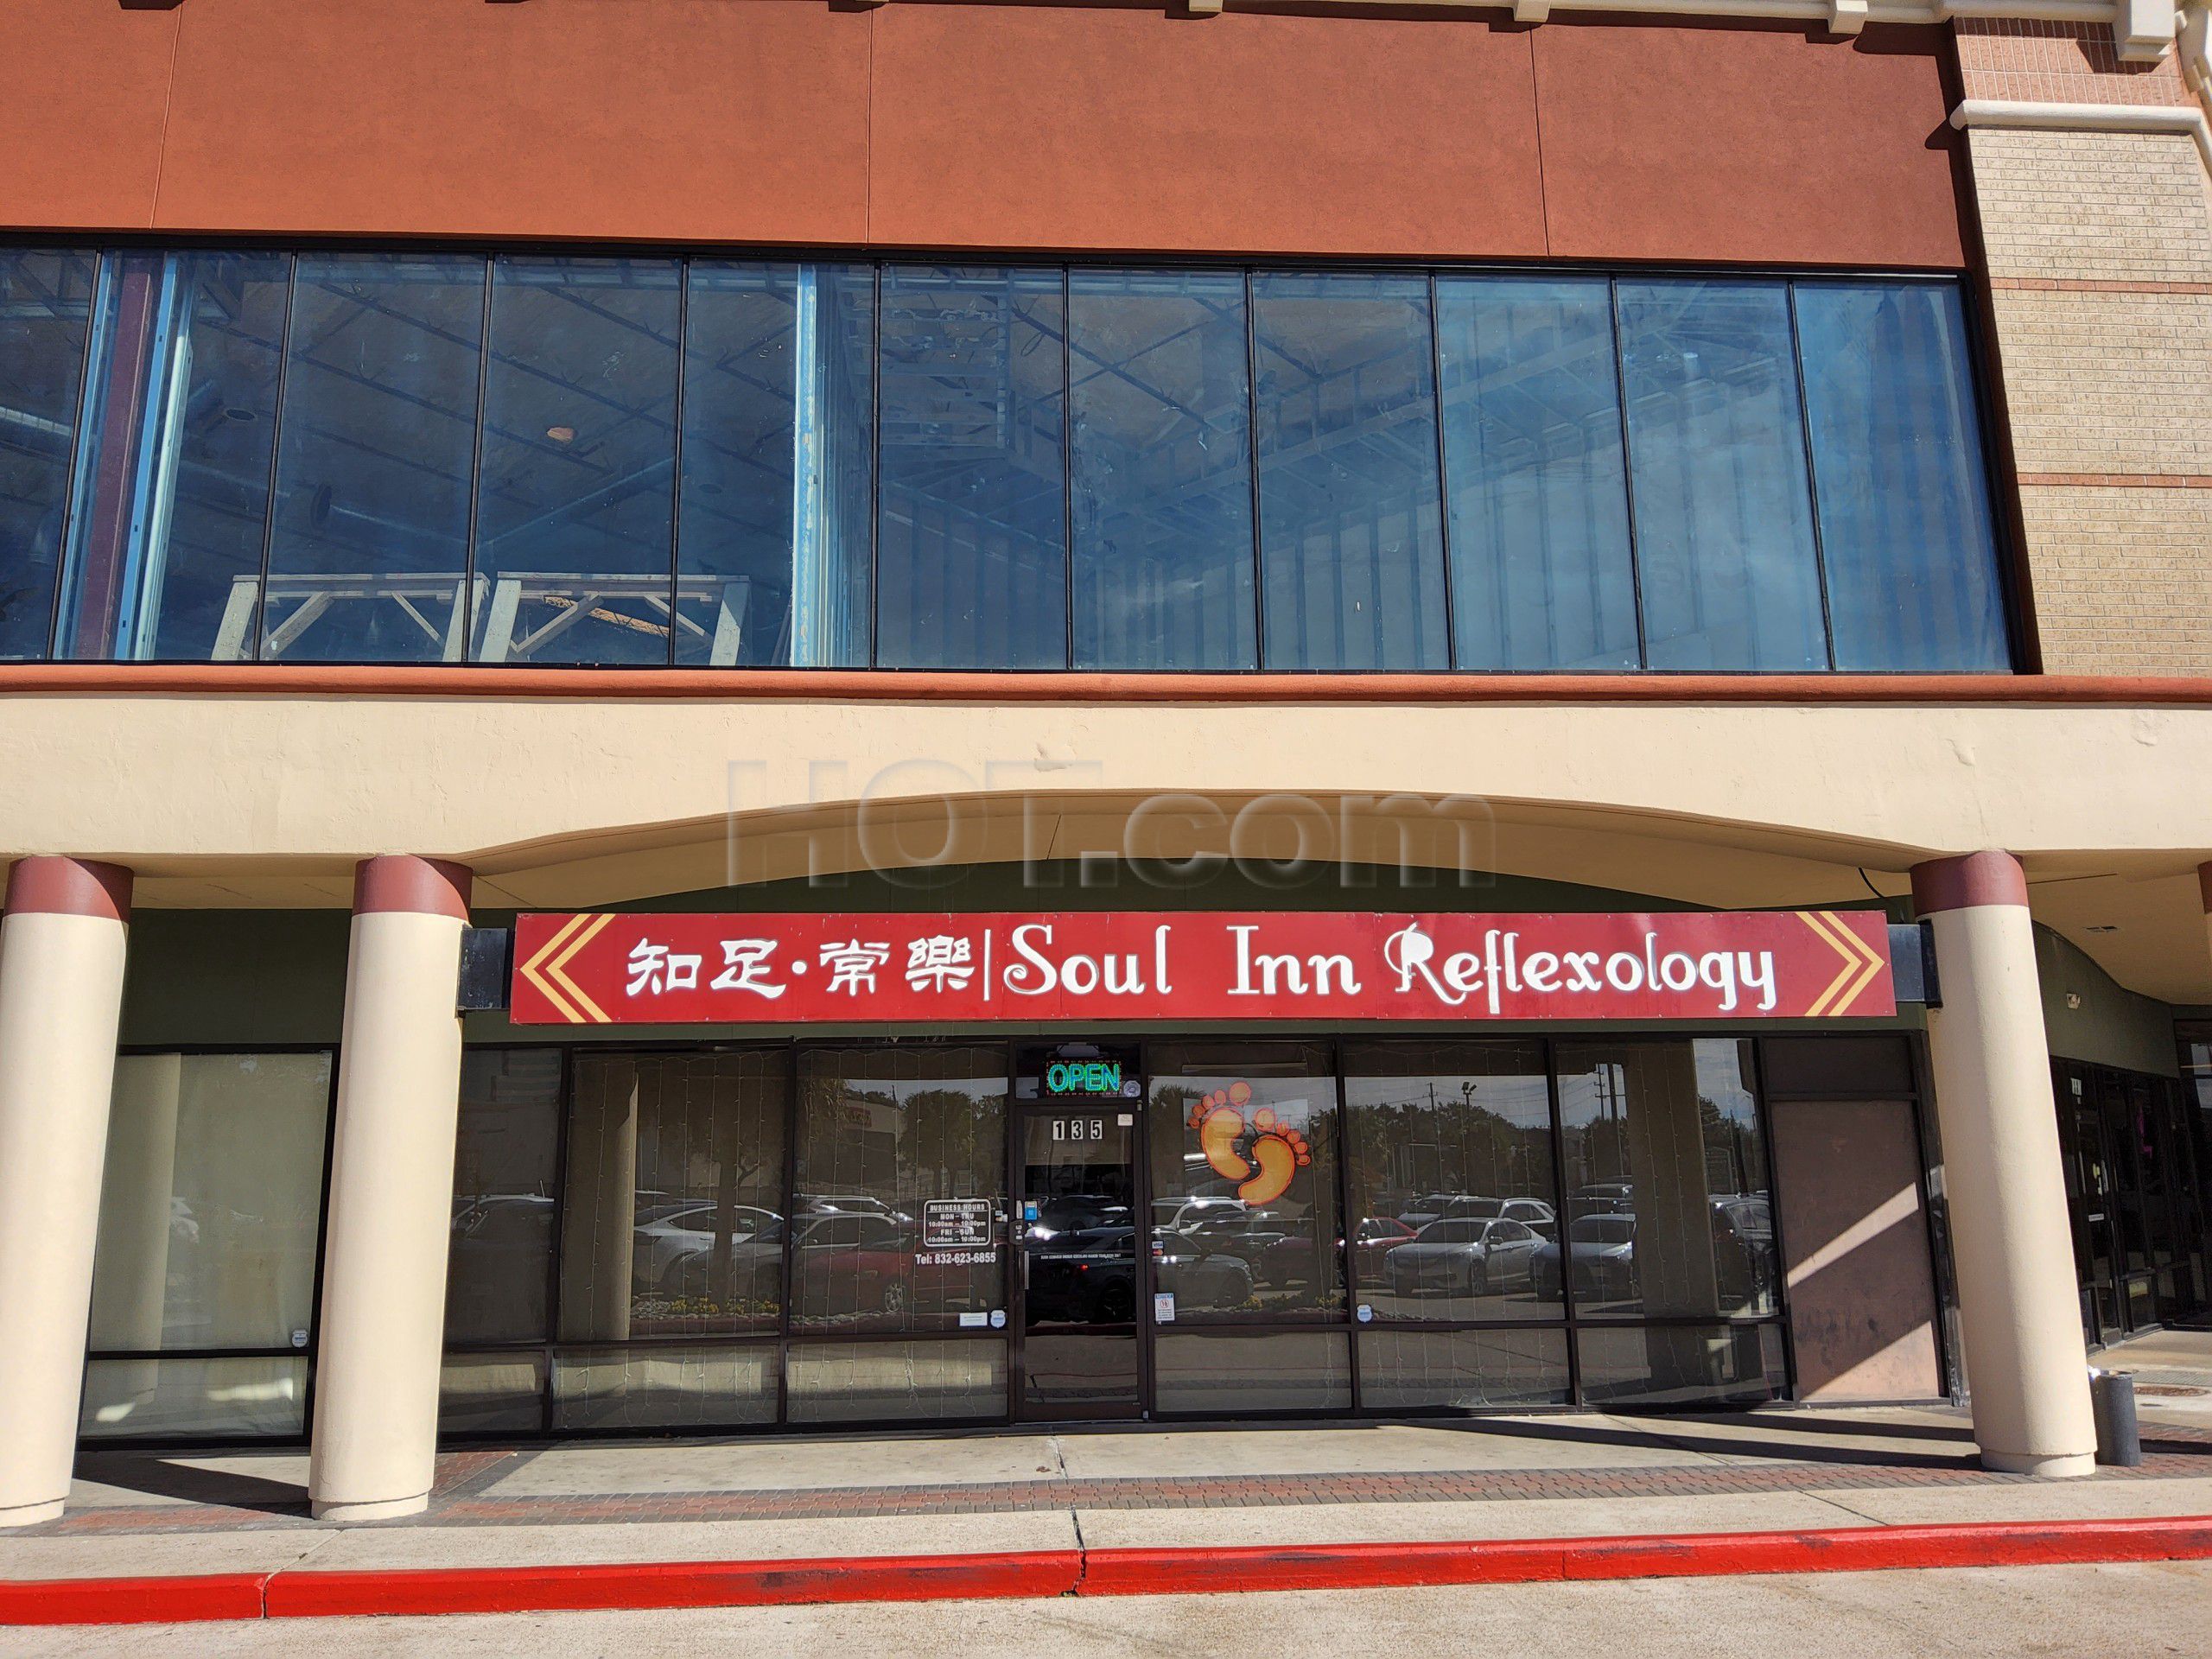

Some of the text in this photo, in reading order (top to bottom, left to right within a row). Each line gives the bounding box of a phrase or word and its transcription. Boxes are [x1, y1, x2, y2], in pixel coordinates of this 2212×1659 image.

[1003, 921, 1777, 1014] Soul Inn Reflexology
[1047, 1064, 1122, 1092] OPEN
[1054, 1121, 1101, 1139] 135
[915, 1252, 996, 1265] Tel: 832-623-6855
